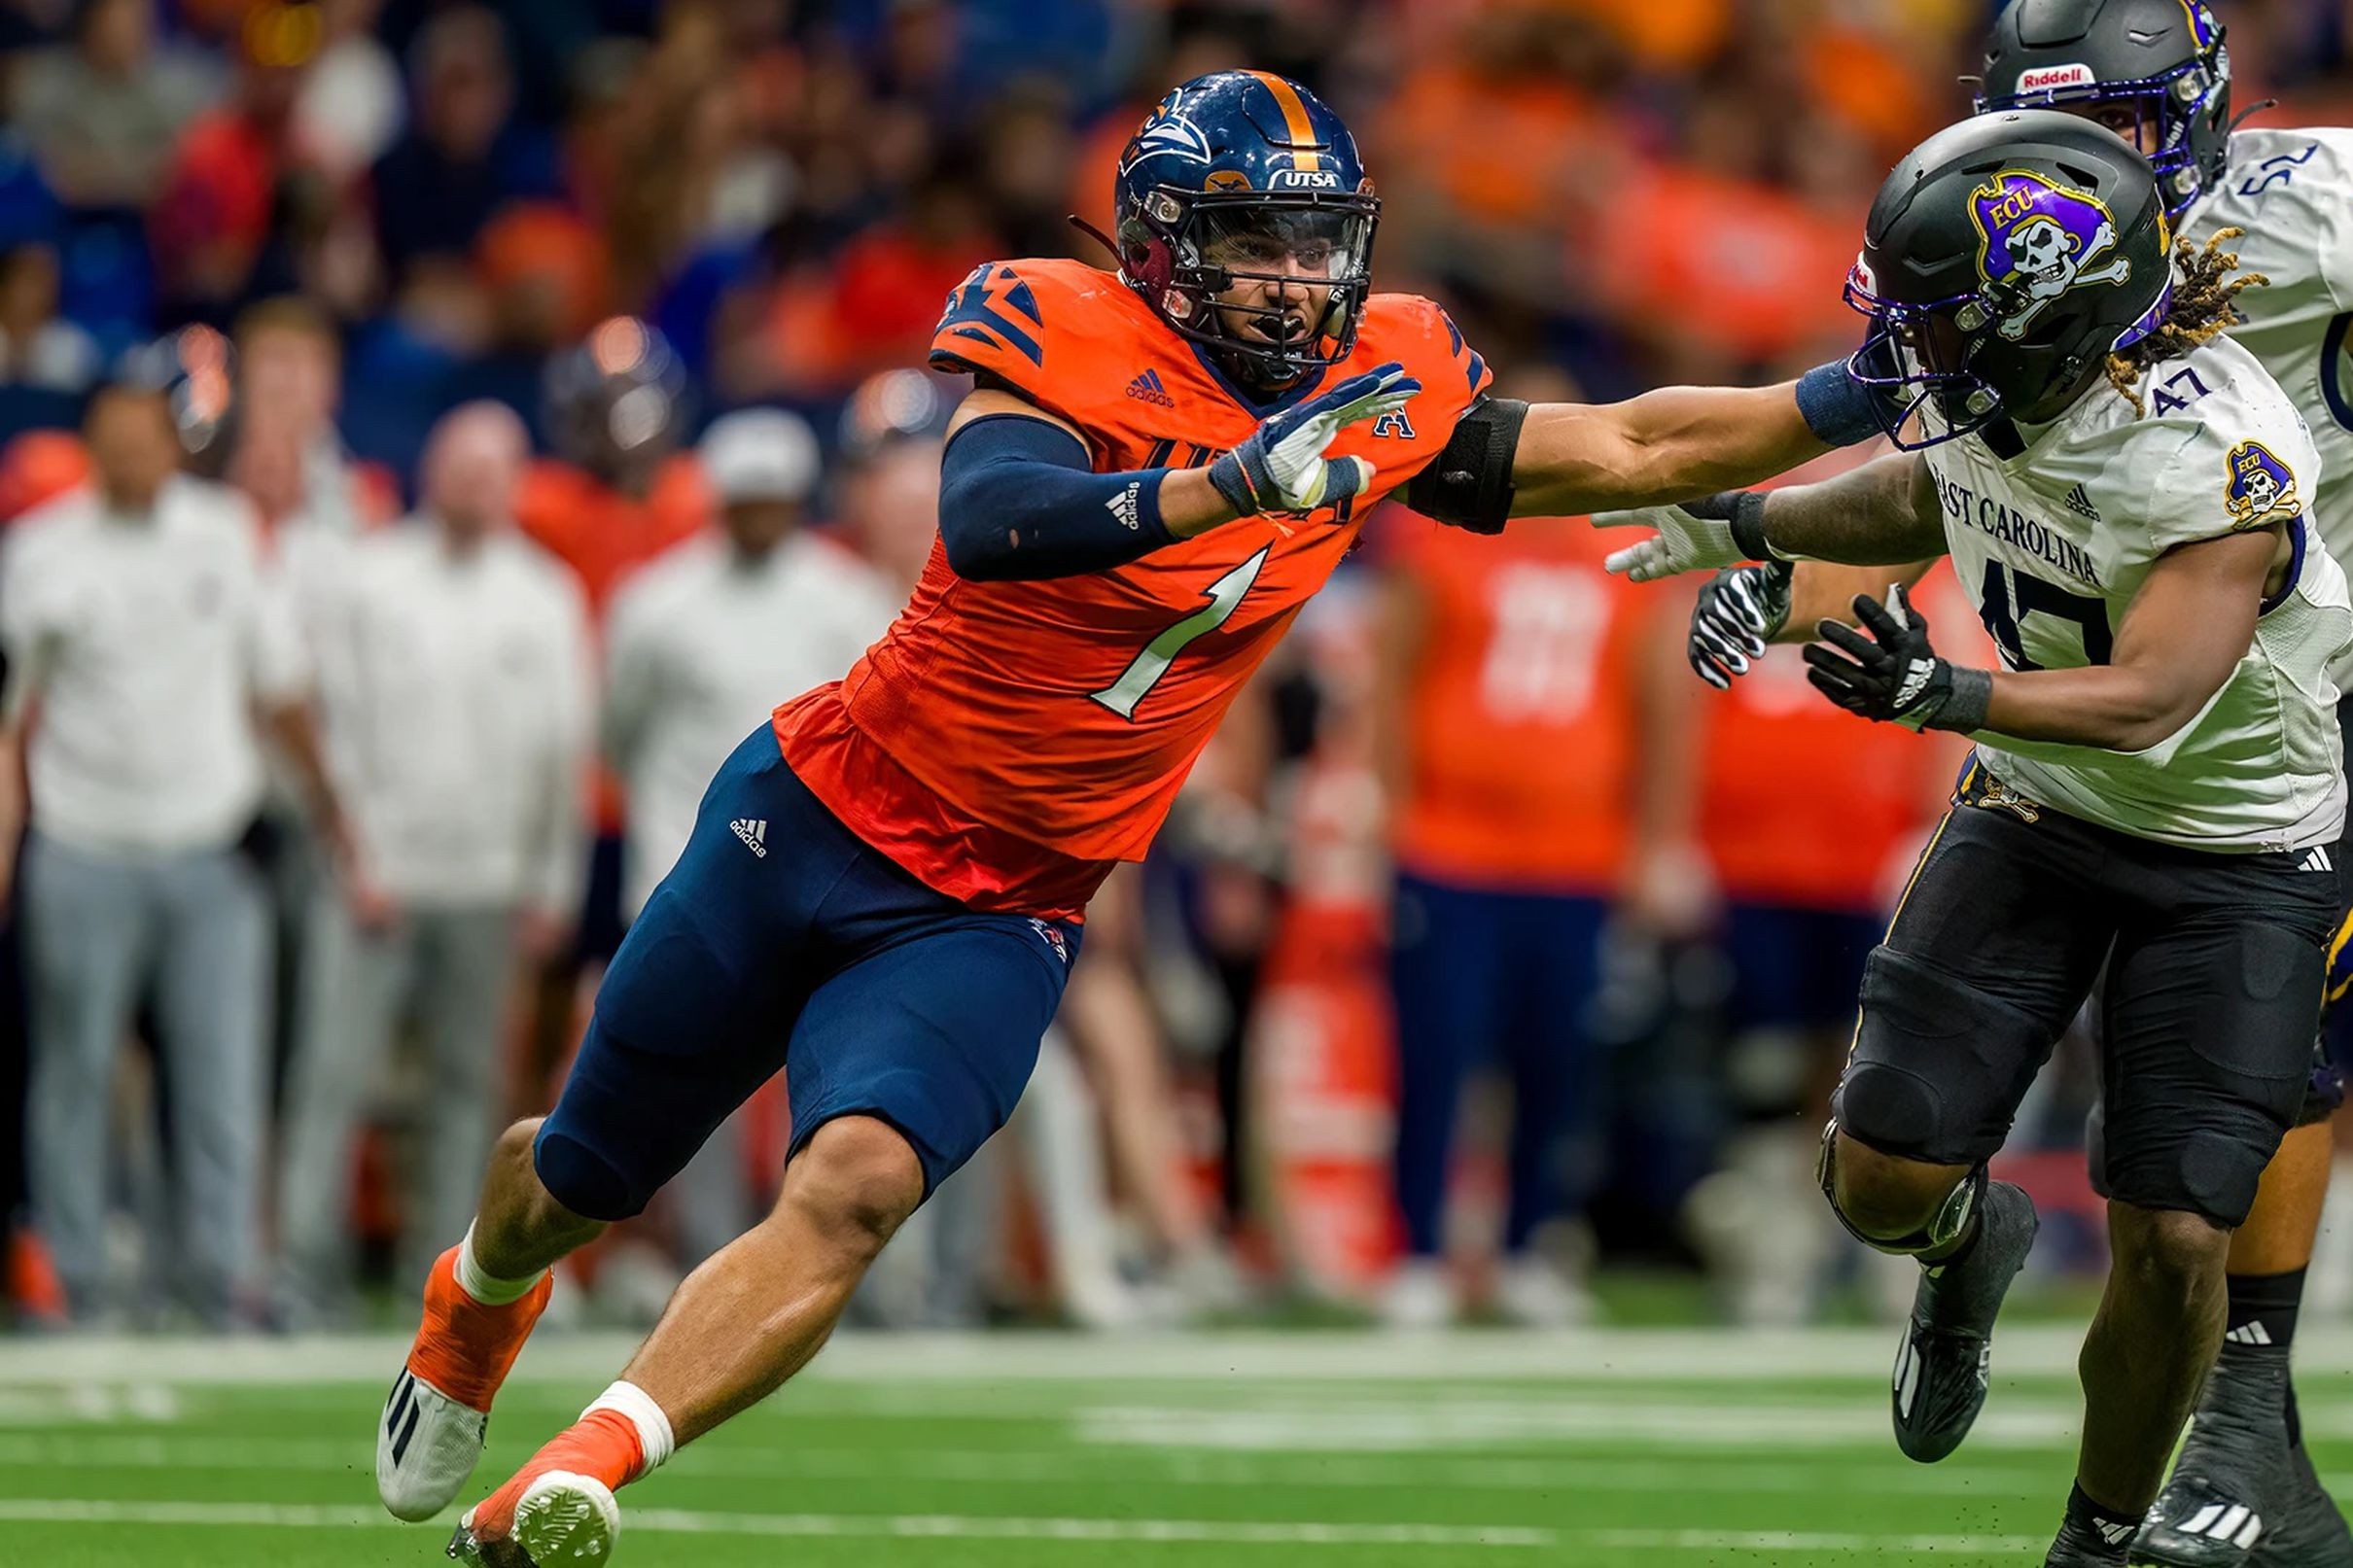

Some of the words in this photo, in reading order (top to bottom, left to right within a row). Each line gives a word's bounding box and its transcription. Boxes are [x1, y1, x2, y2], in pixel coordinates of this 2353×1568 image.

[2023, 68, 2082, 87] Riddell
[1284, 171, 1337, 188] UTSA
[1989, 186, 2034, 229] ECU
[1125, 386, 1175, 408] adidas
[2152, 366, 2213, 418] 47
[2237, 452, 2262, 473] ECU
[1125, 481, 1141, 531] adidas
[2064, 498, 2101, 523] adidas
[1979, 498, 2103, 589] CAROLINA
[1085, 539, 1277, 724] 1
[729, 819, 767, 858] adidas
